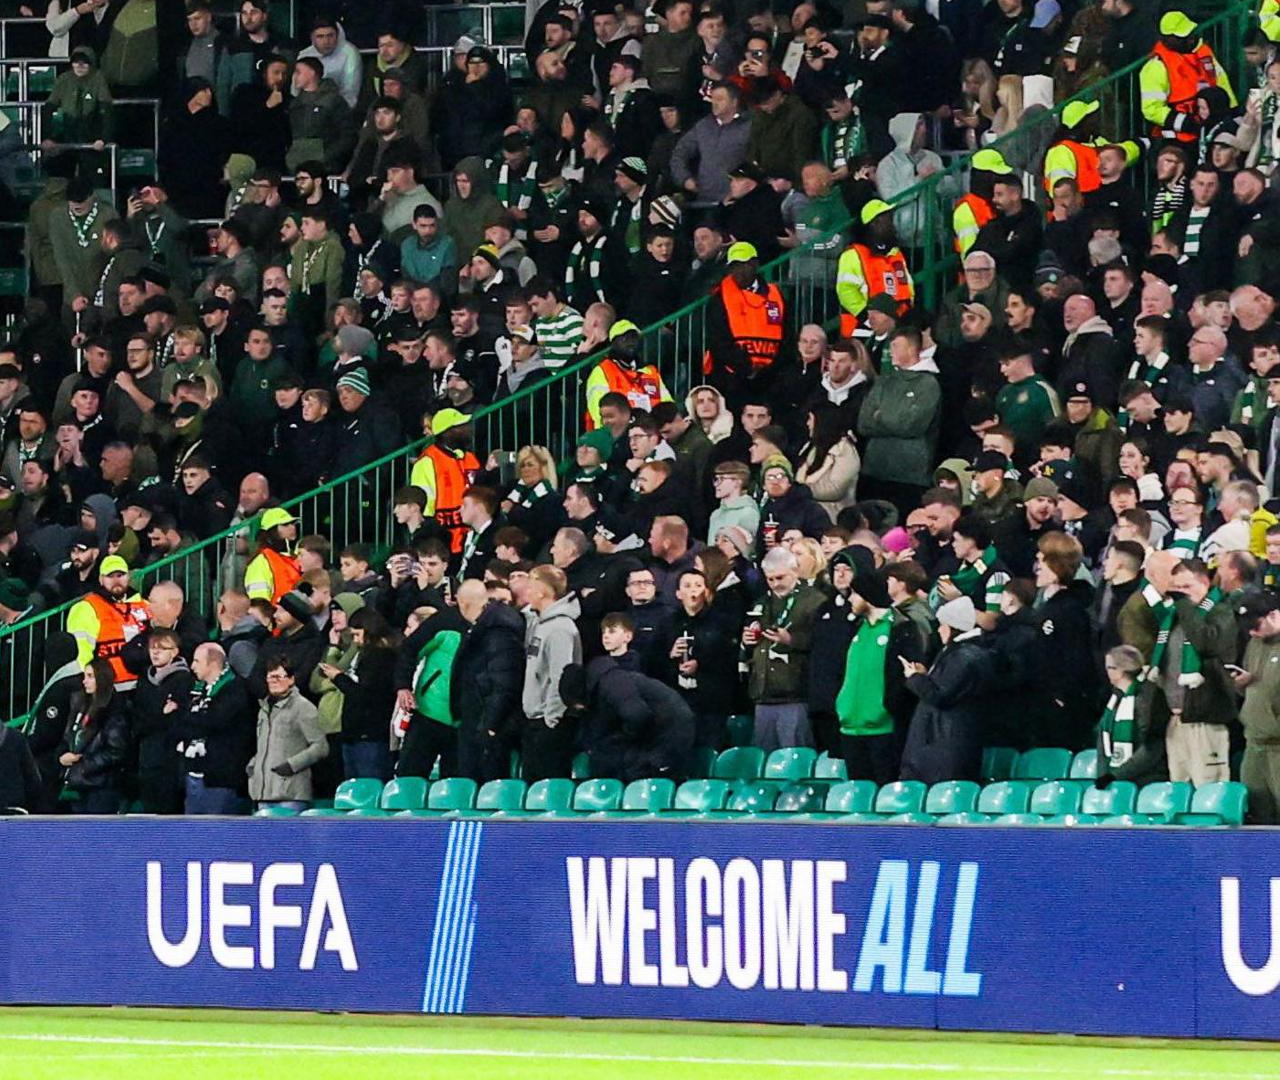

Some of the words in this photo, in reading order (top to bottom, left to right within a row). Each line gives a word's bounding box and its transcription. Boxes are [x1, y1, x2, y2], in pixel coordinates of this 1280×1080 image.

[146, 860, 359, 971] UEFA
[566, 856, 848, 992] WELCOME
[852, 859, 983, 996] ALL
